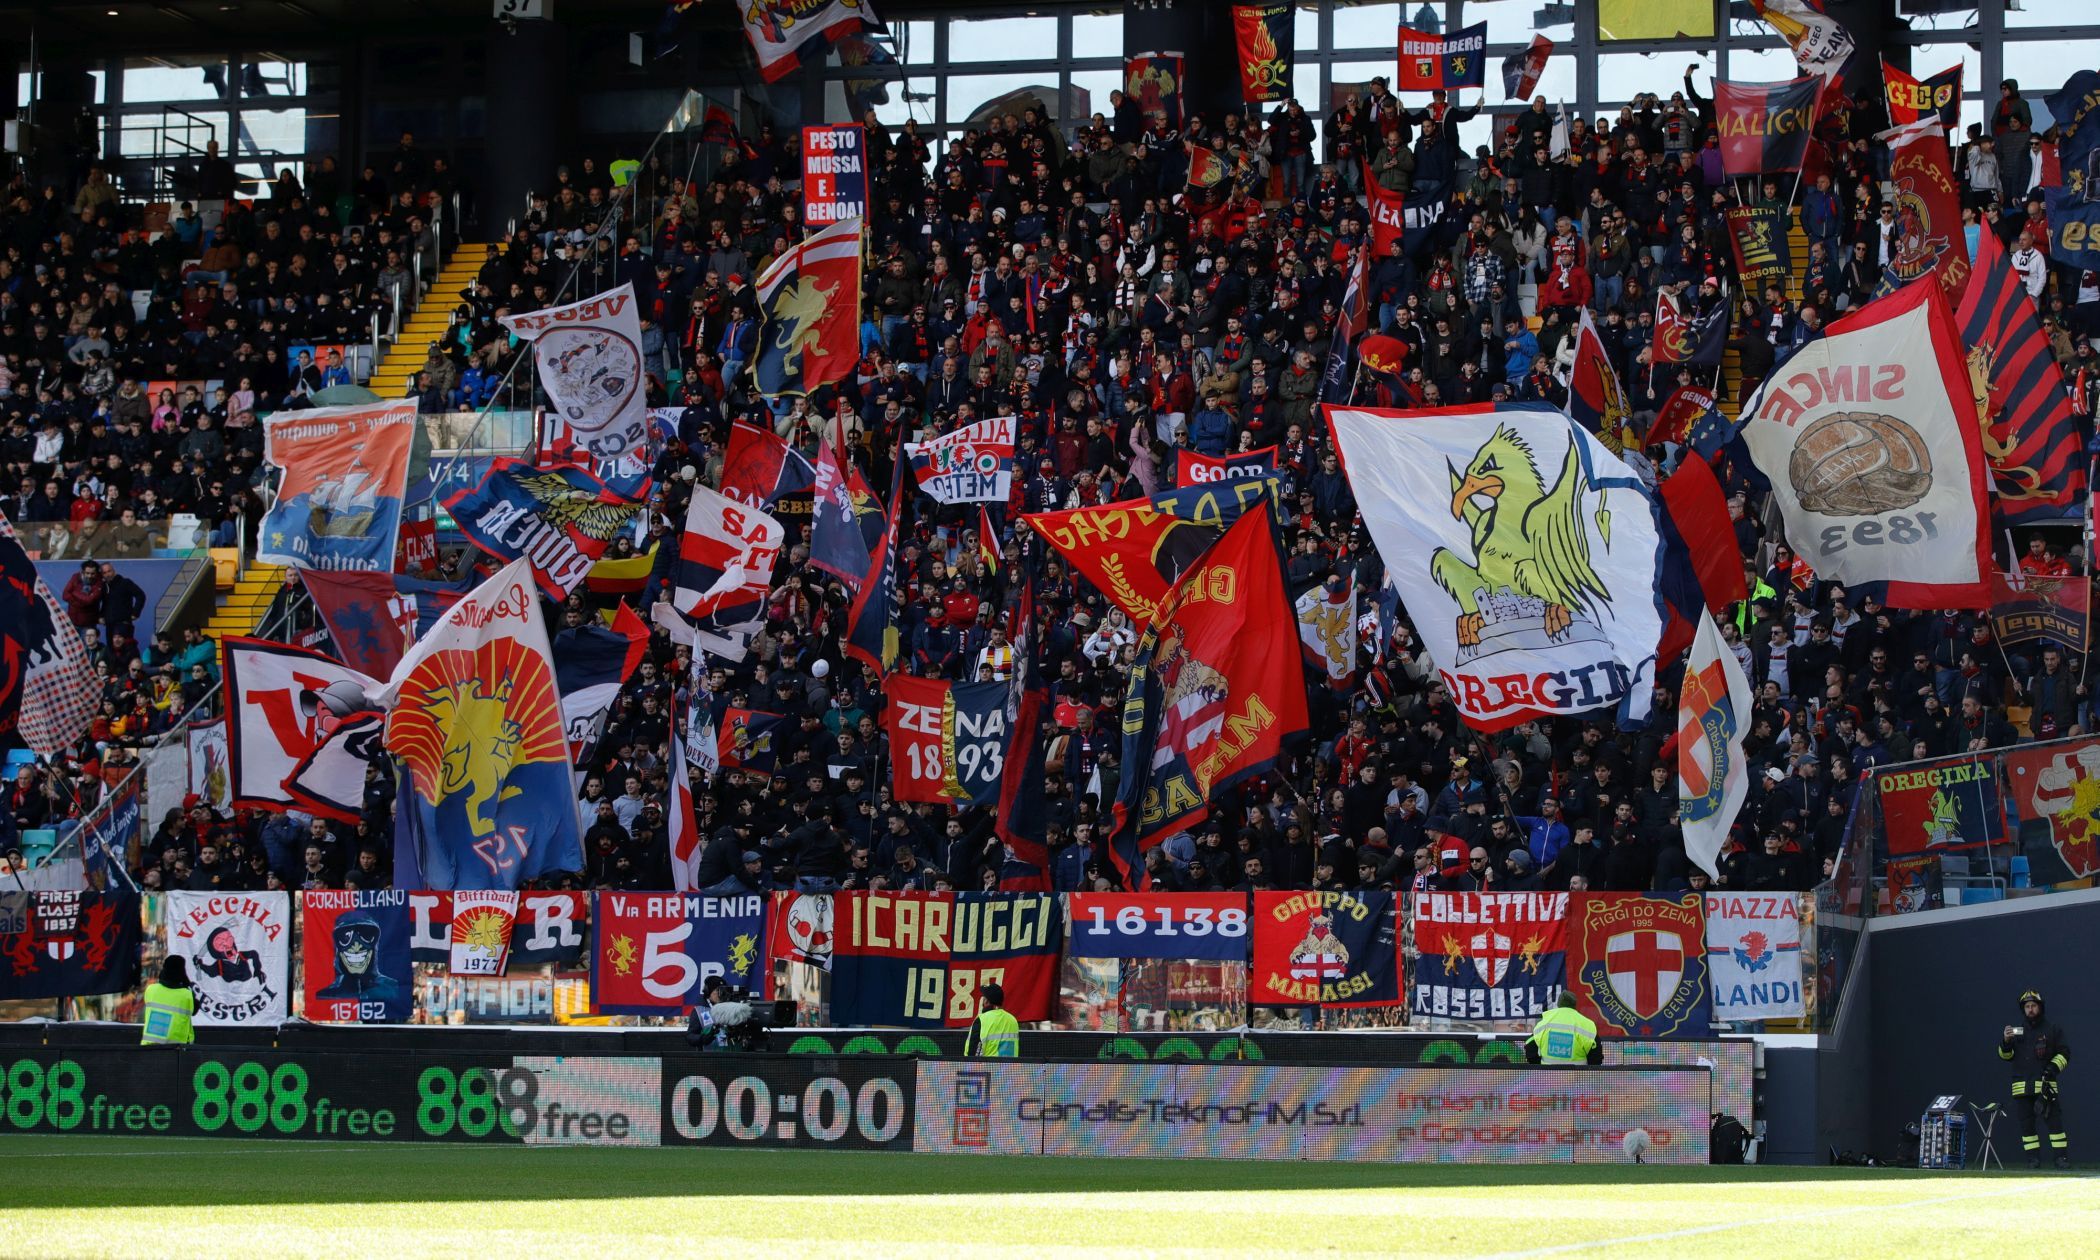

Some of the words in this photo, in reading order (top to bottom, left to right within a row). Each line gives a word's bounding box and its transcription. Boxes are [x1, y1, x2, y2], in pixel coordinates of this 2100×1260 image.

[1403, 35, 1483, 56] HEIDELBERG
[809, 130, 856, 150] PESTO
[807, 154, 862, 174] MUSSA
[806, 200, 864, 221] GENOA!
[1680, 390, 1713, 411] GENOA
[1879, 761, 1991, 794] OREGINA
[39, 890, 82, 903] FIRST
[305, 889, 405, 909] CORNIGLIANO
[647, 895, 761, 919] ARMENIA
[1272, 890, 1370, 923] GRUPPO
[1705, 897, 1798, 920] PIAZZA
[177, 895, 284, 943] VECCHIA
[852, 896, 1052, 953] ICARUGGI
[1087, 906, 1247, 938] 16138
[1589, 908, 1629, 932] FIGGI
[1659, 905, 1698, 929] ZENA
[1631, 919, 1653, 928] 1995
[463, 957, 500, 971] 1977
[1266, 970, 1375, 1002] MARASSI
[1591, 969, 1638, 1029] SUPPORTERS
[1662, 978, 1695, 1020] GENOA
[1714, 980, 1800, 1008] LANDI
[330, 1001, 386, 1021] 16152
[0, 1059, 86, 1130] 88
[89, 1094, 172, 1130] free
[192, 1060, 309, 1133] 888
[312, 1098, 396, 1135] free
[543, 1102, 630, 1139] free
[671, 1075, 905, 1142] 00:00
